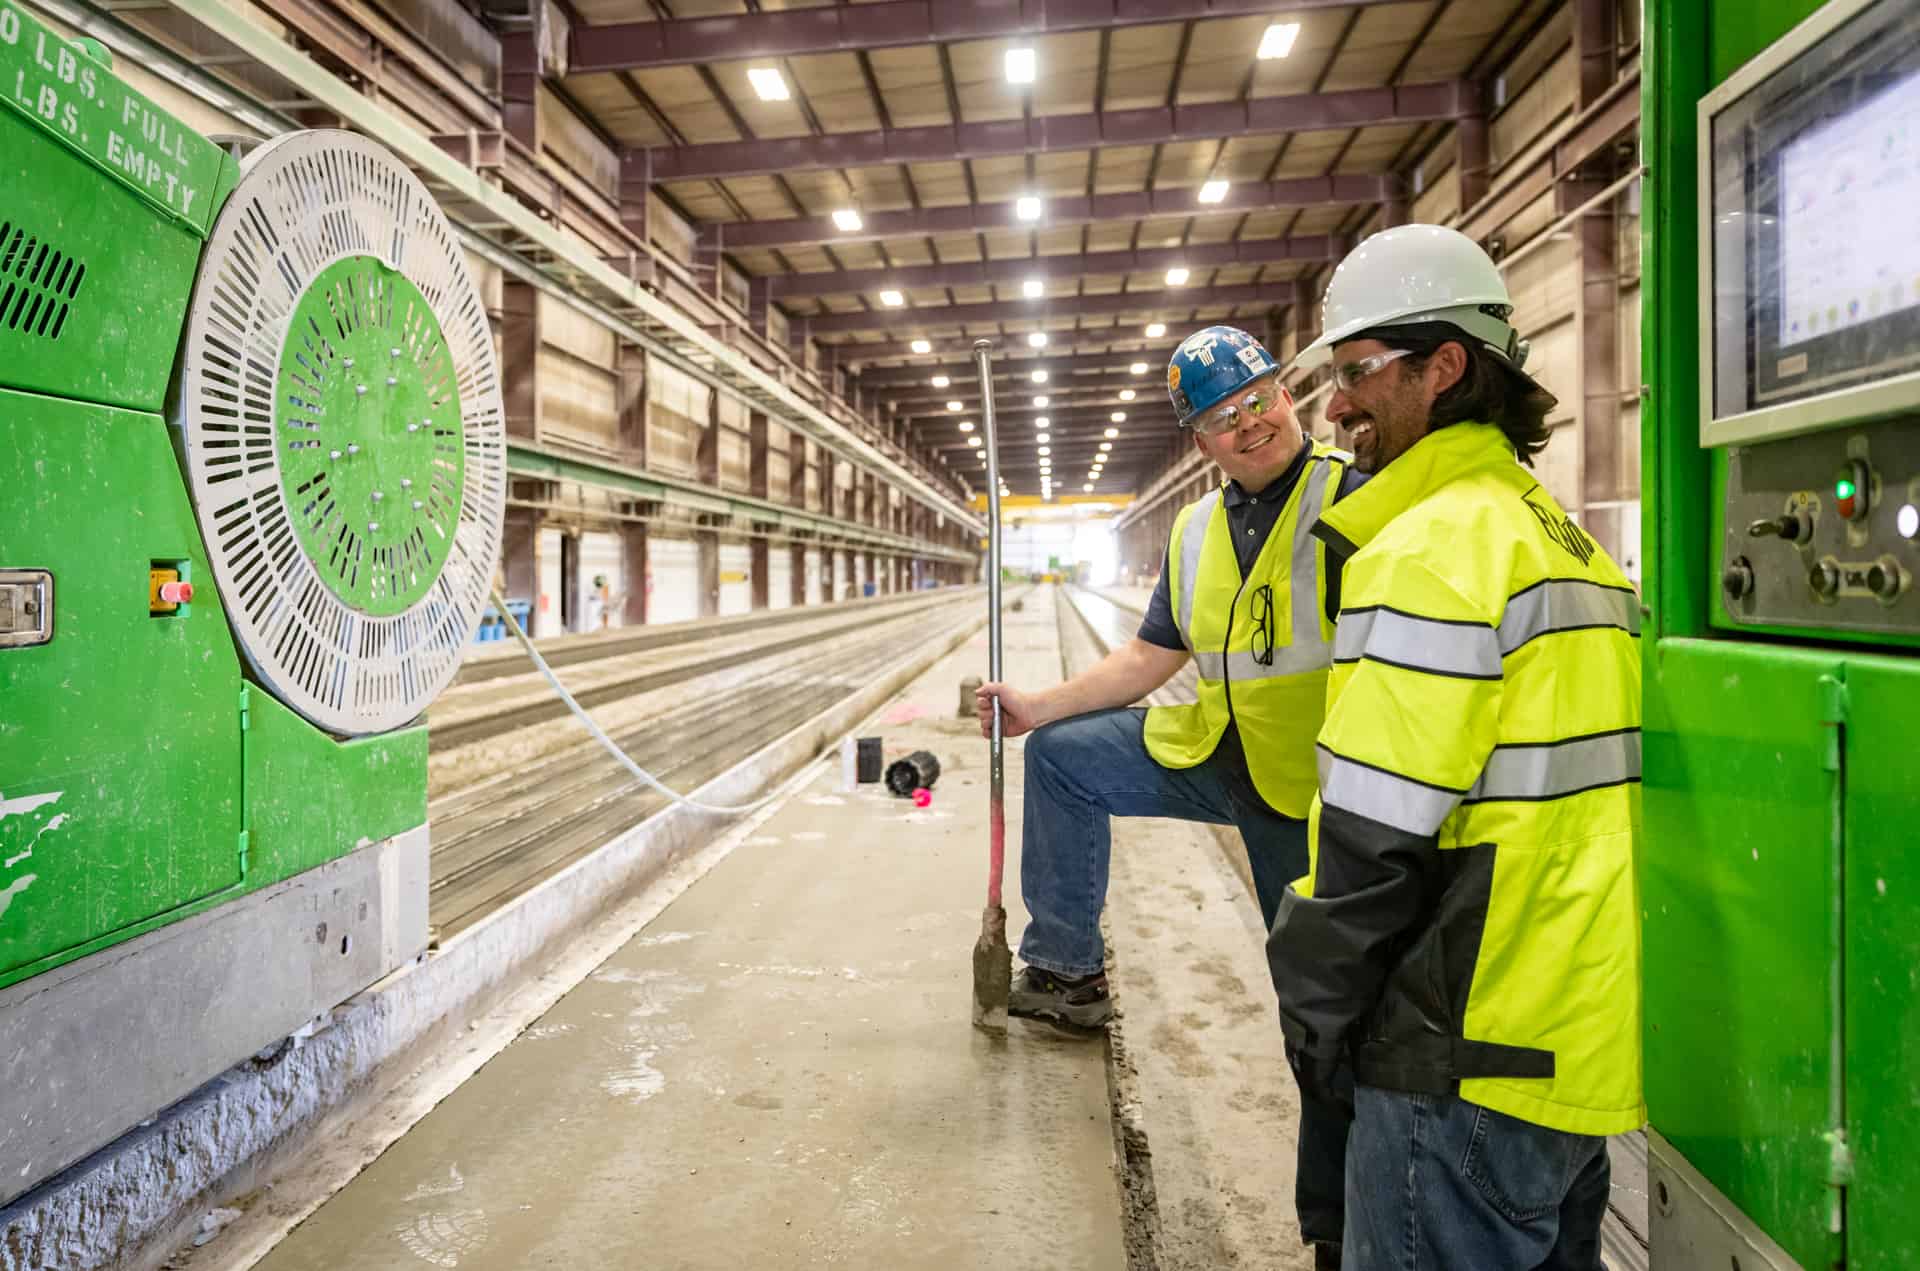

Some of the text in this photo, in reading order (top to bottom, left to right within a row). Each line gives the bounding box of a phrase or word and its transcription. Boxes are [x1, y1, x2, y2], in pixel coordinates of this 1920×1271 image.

[15, 68, 196, 216] LBS. EMPTY
[35, 31, 105, 109] LBS.
[122, 95, 189, 167] FULL
